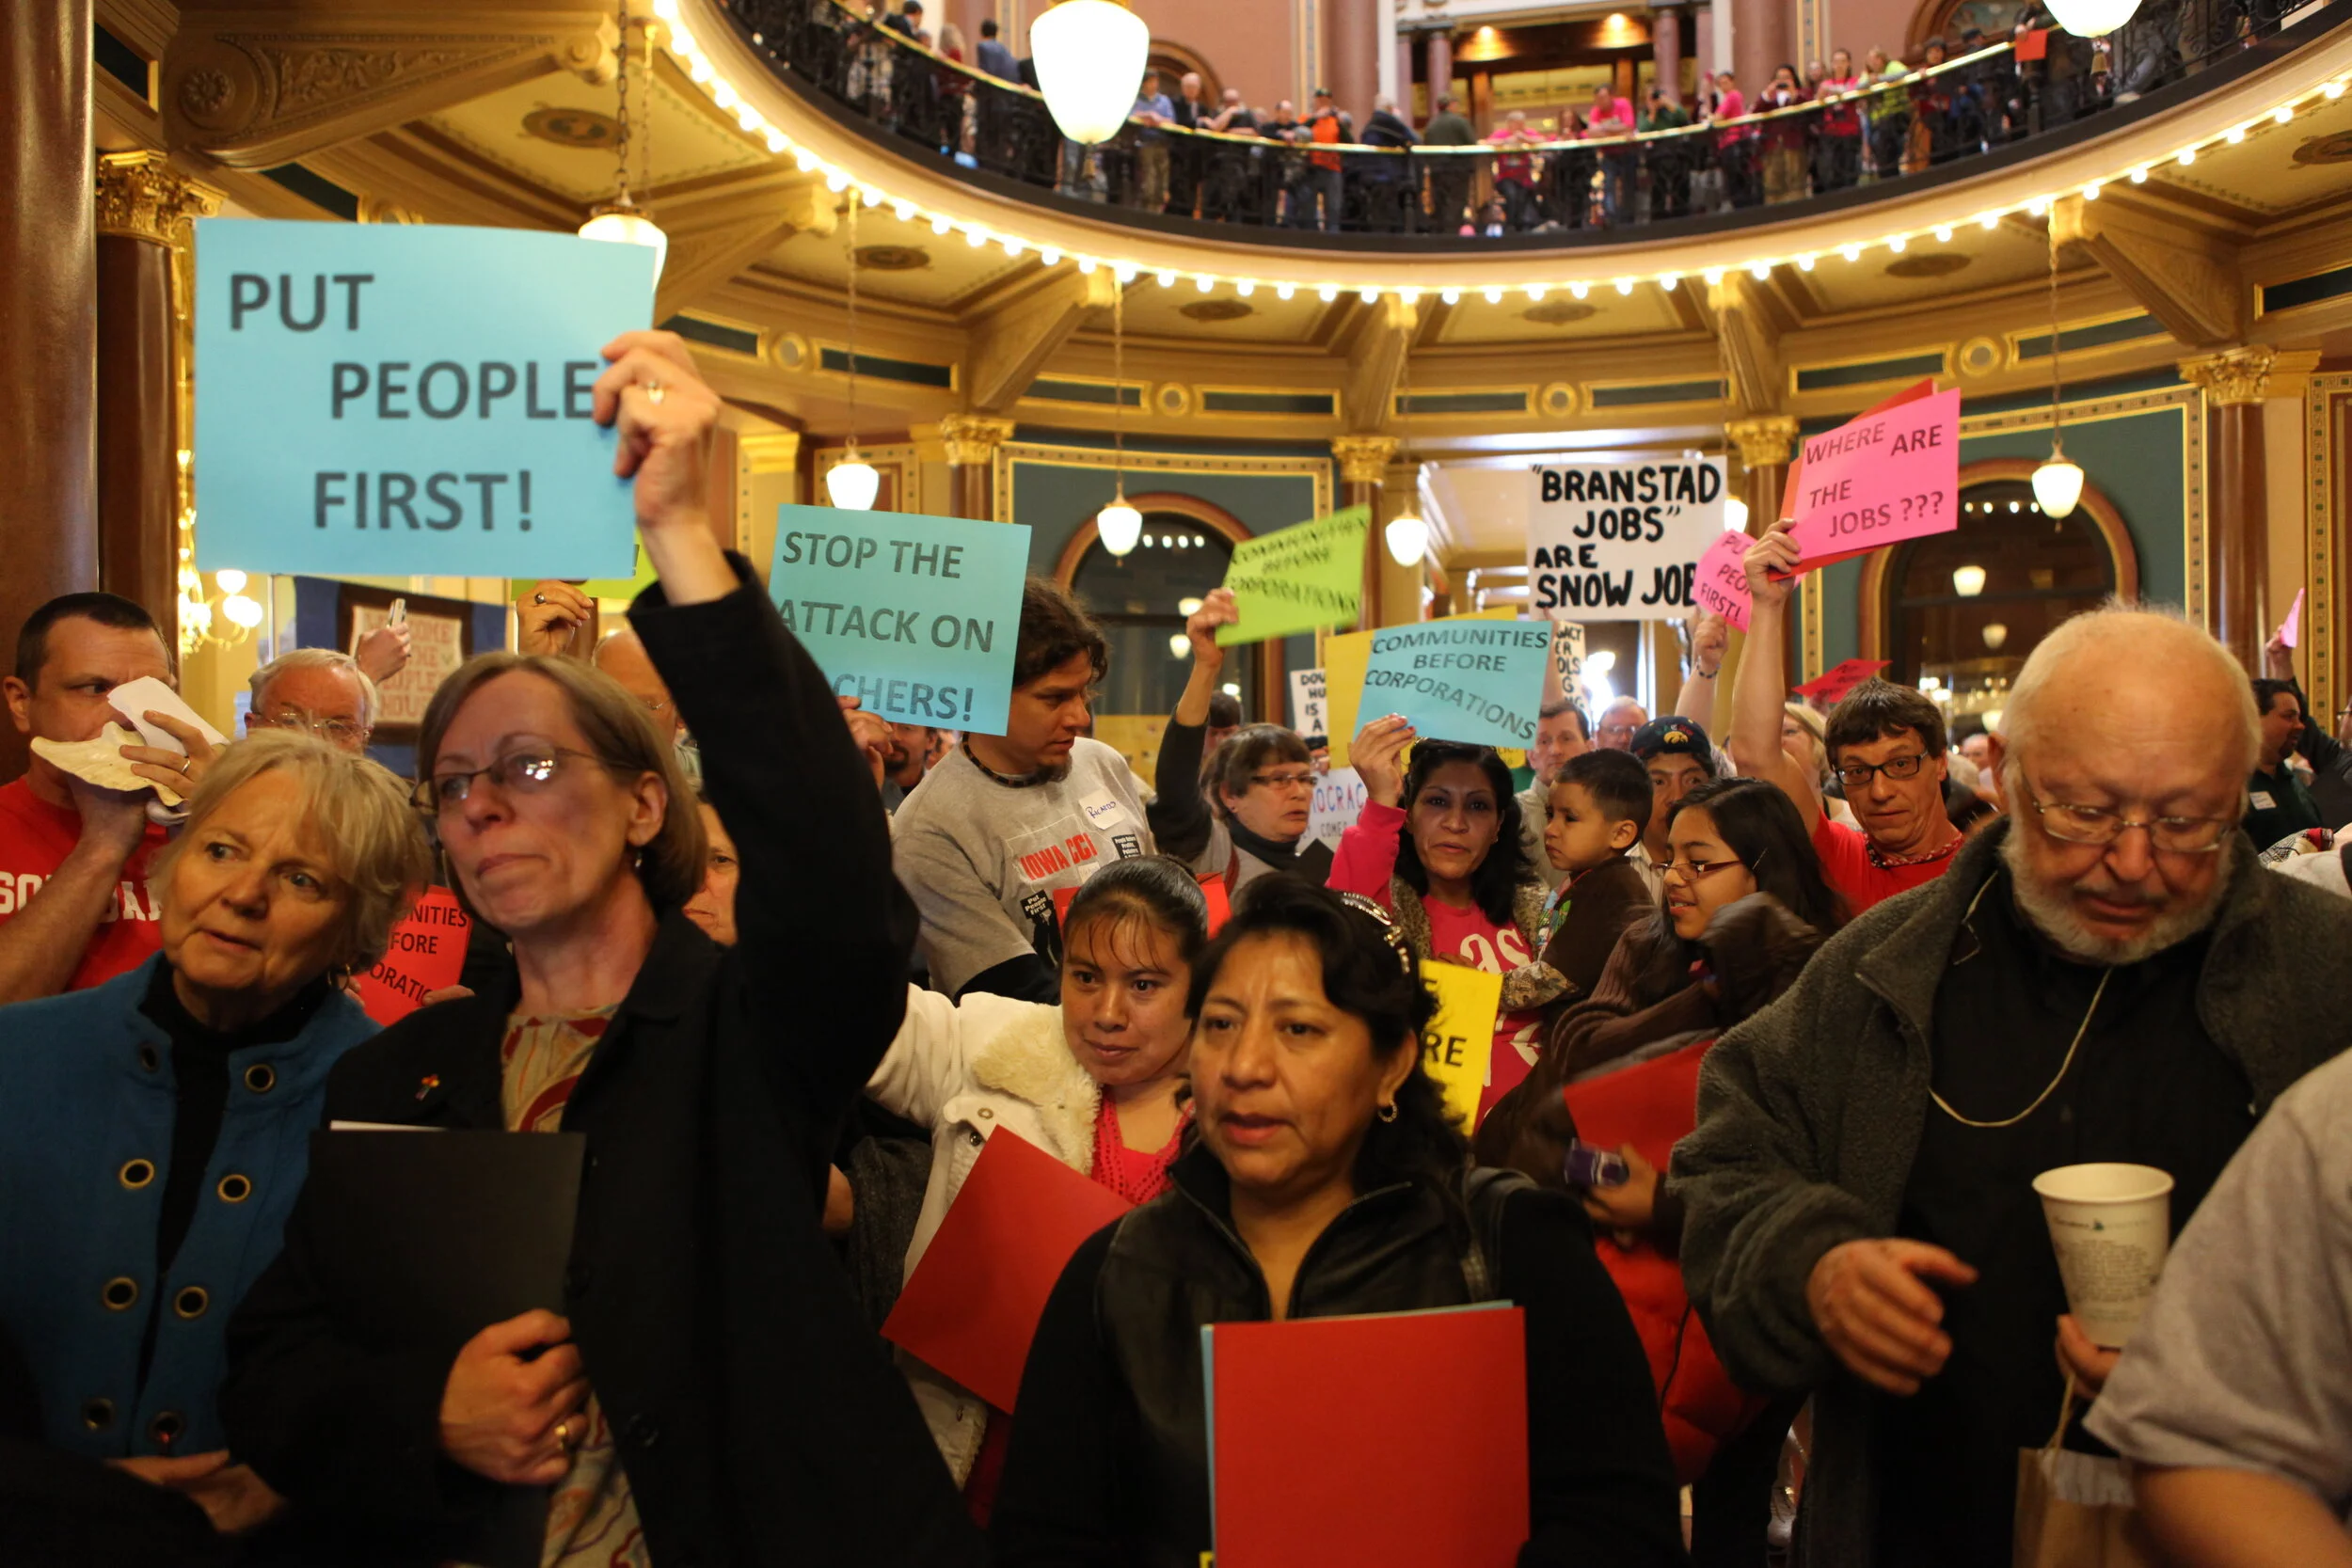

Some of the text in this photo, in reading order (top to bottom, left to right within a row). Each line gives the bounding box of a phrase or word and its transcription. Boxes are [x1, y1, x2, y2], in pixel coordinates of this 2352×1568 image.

[229, 273, 374, 333] PUT
[331, 360, 600, 420] PEOPLE
[1806, 421, 1943, 465] WHERE ARE
[313, 469, 533, 532] FIRST!
[1532, 464, 1721, 504] "BRANSTAD
[1809, 479, 1852, 509] THE
[1572, 505, 1681, 542] JOBS"
[1829, 490, 1944, 538] JOBS ???
[782, 531, 964, 578] STOP THE
[1534, 544, 1598, 568] ARE
[1722, 533, 1752, 555] PU
[1535, 569, 1633, 609] SNOW
[1716, 563, 1752, 595] PEO
[1700, 579, 1742, 622] FIRST!
[779, 598, 994, 653] ATTACK ON
[1373, 628, 1549, 654] COMMUNITIES
[1413, 653, 1507, 673] BEFORE
[833, 673, 974, 722] CHERS!
[1308, 688, 1327, 698] HU
[1364, 669, 1536, 740] CORPORATIONS
[1312, 783, 1365, 813] OCRAC
[1020, 845, 1071, 880] IOWA
[1065, 832, 1098, 864] CCI
[409, 904, 468, 927] NITIES
[389, 931, 439, 954] FORE
